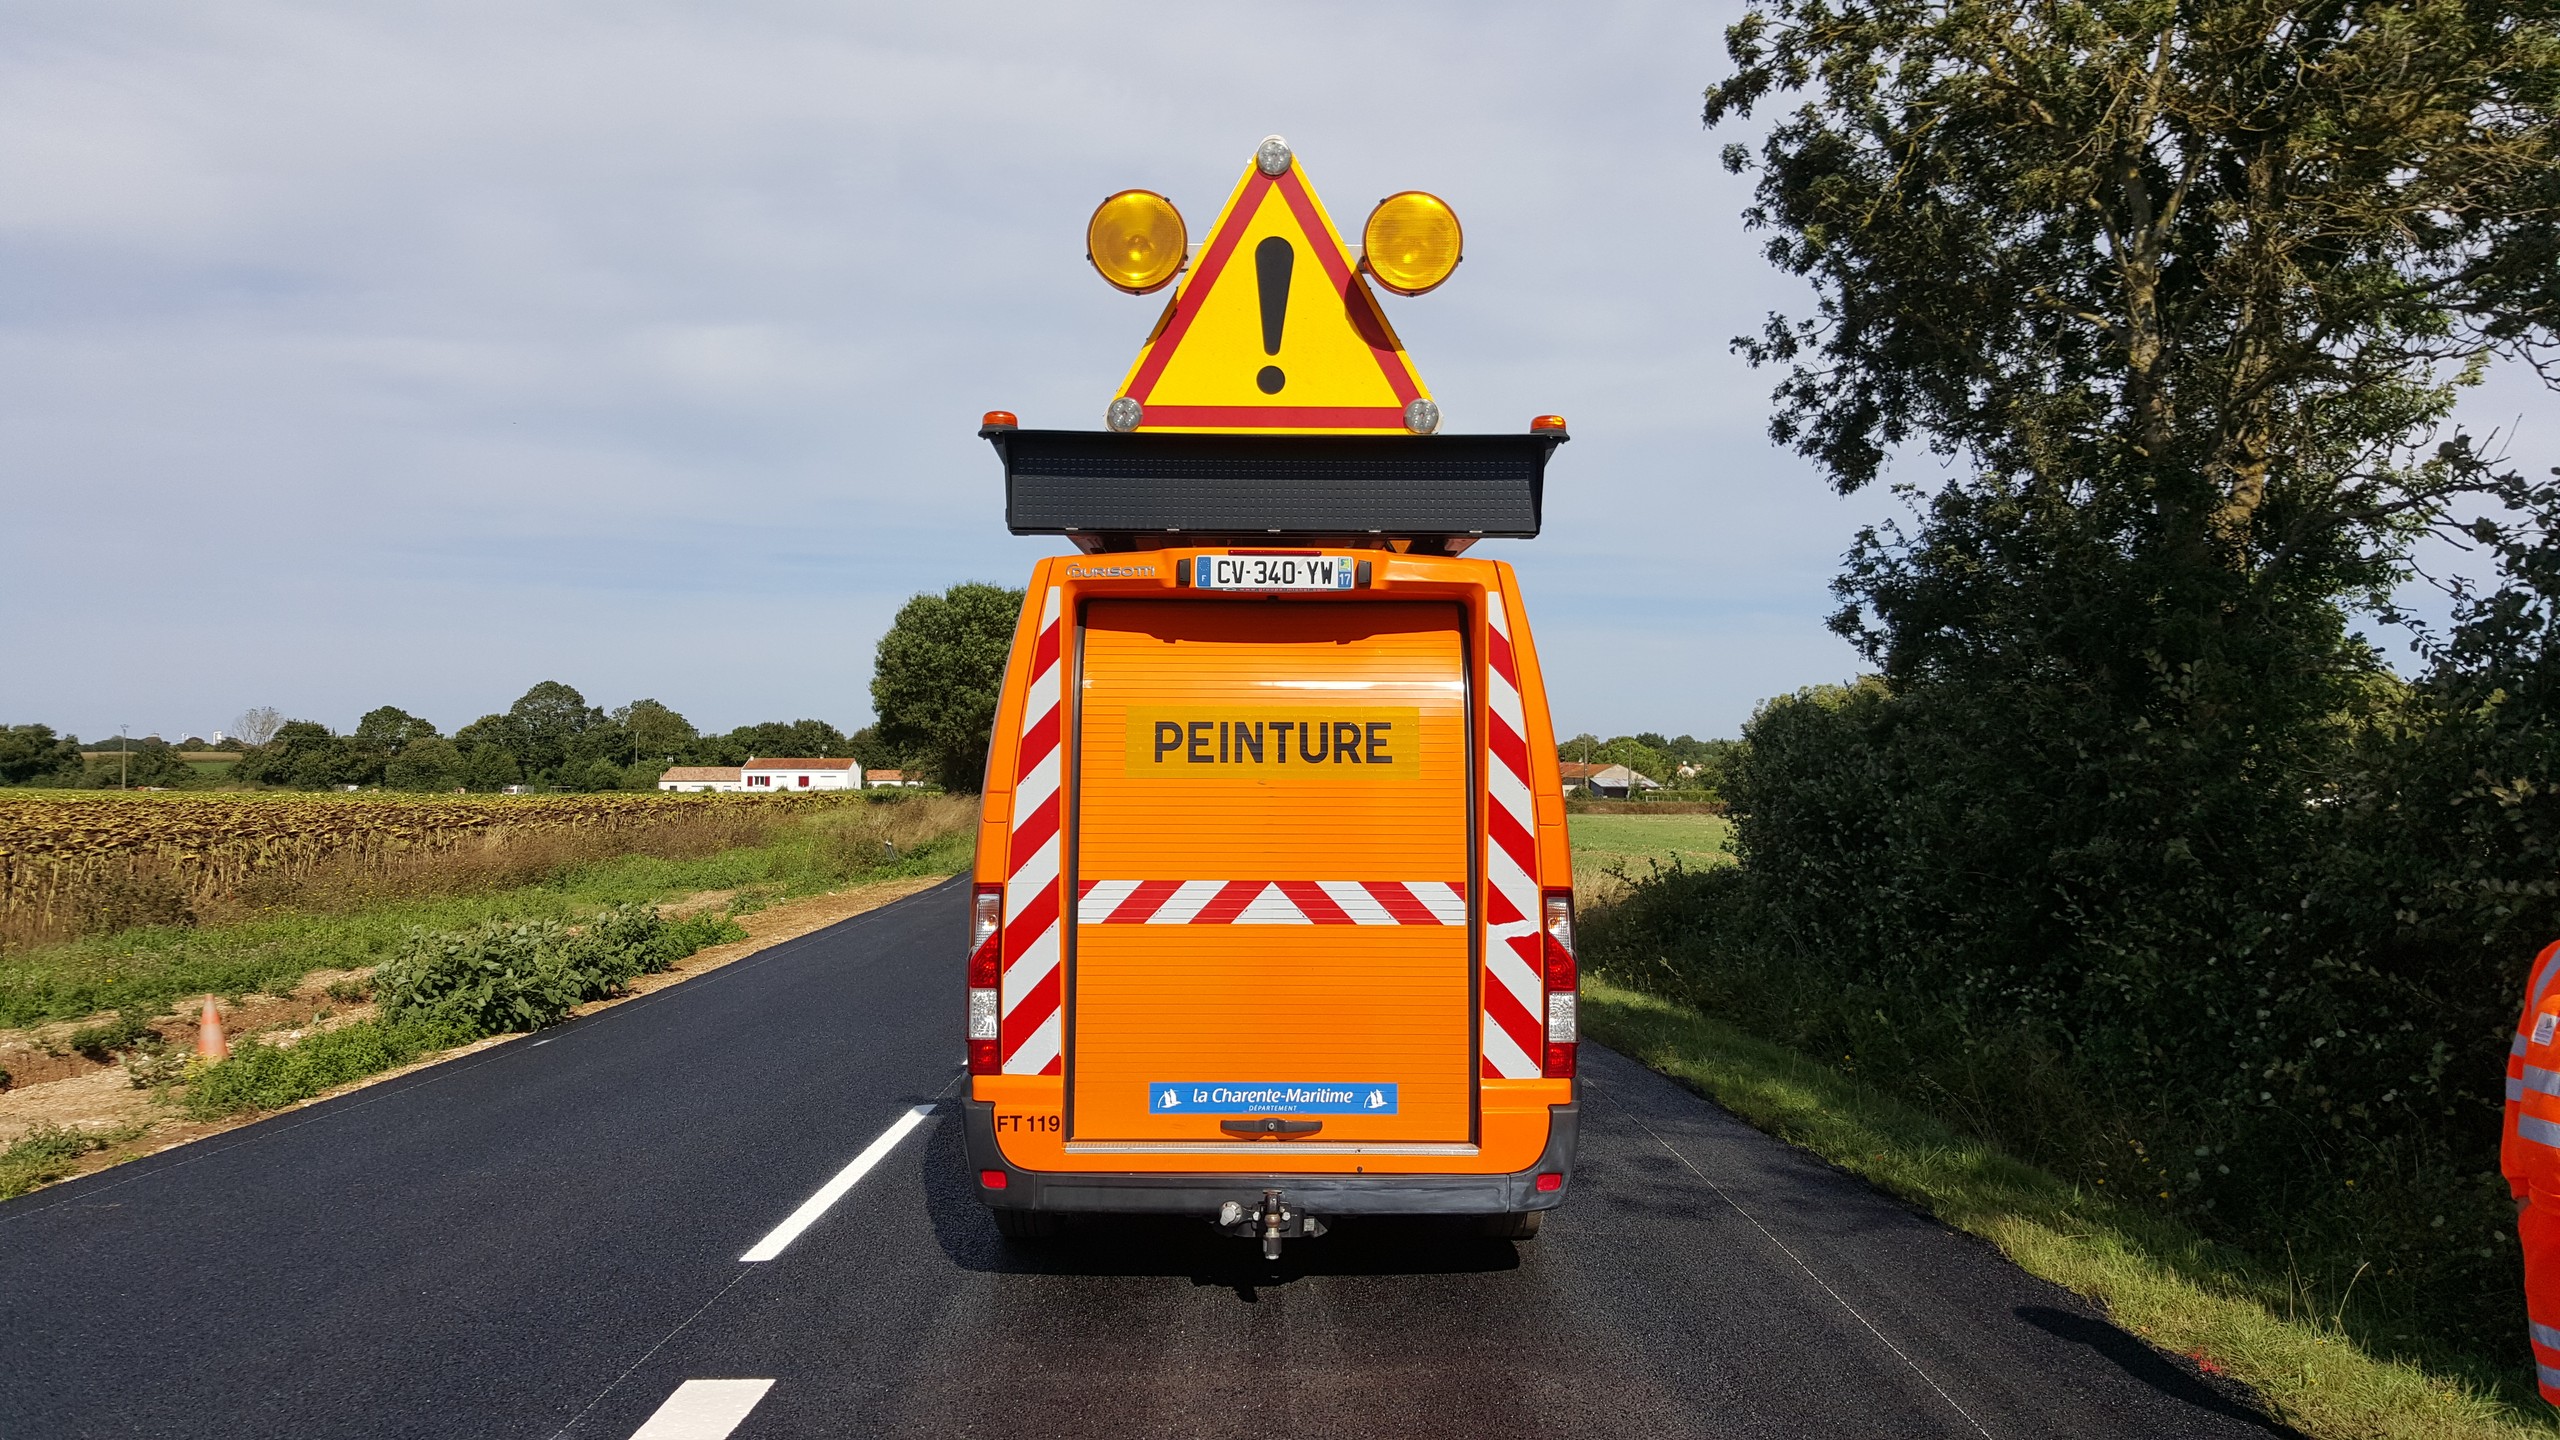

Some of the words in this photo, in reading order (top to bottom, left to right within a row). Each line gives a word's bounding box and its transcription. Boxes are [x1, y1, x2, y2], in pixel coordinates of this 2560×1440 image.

[1066, 563, 1155, 578] DURISOTTI
[1201, 574, 1207, 582] F
[1217, 560, 1333, 585] CV-340-YW
[1339, 573, 1351, 586] 17
[1154, 721, 1393, 764] PEINTURE
[1192, 1088, 1208, 1103] la
[1212, 1088, 1354, 1103] Charente-Maritime
[1248, 1104, 1297, 1112] DÉPARTEMENT
[997, 1116, 1023, 1132] FT
[1027, 1115, 1060, 1132] 119
